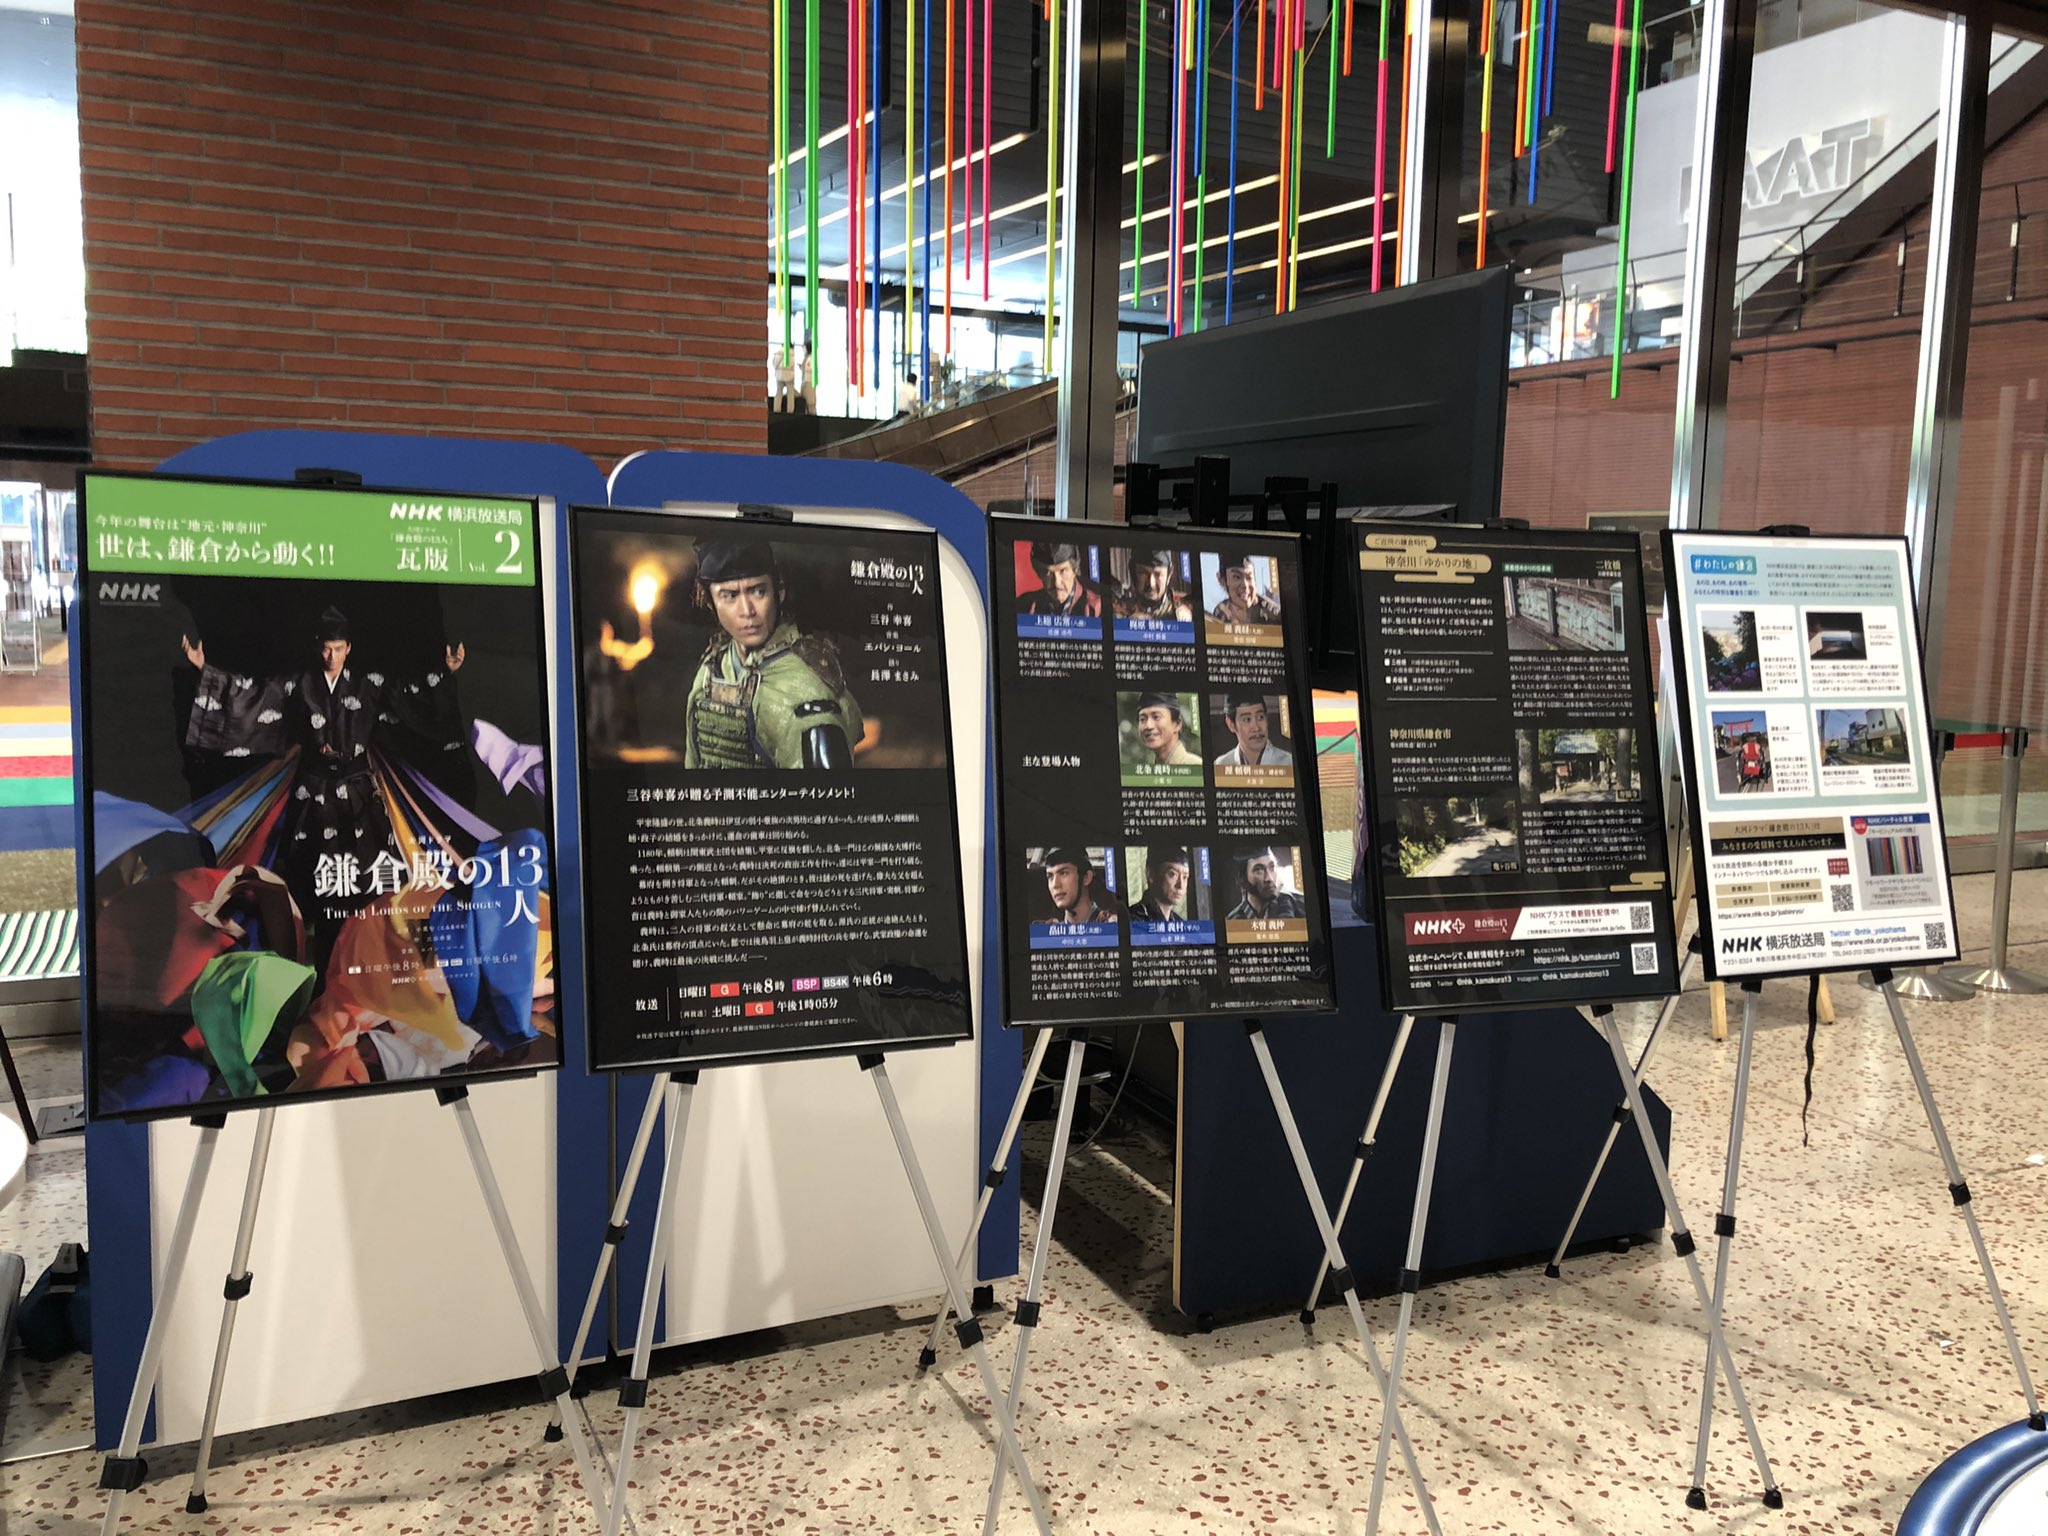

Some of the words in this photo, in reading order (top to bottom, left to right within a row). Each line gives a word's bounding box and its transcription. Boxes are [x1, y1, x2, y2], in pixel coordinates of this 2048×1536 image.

[390, 502, 443, 521] NHK
[448, 506, 522, 526] 横浜放送局
[397, 546, 449, 572] 瓦版
[494, 529, 522, 574] 2
[99, 582, 161, 601] NHK
[1022, 754, 1081, 768] 主な登場人物
[1721, 935, 1762, 954] NHK
[1766, 931, 1826, 951] 横浜放送局
[679, 985, 707, 999] 日曜日
[741, 977, 785, 995] 午後8時
[796, 978, 818, 990] BSP
[823, 976, 849, 988] BS4K
[852, 970, 893, 987] 午後6時
[635, 998, 659, 1011] 放送
[712, 1004, 741, 1018] 土曜日
[777, 997, 838, 1013] 午後1時05分
